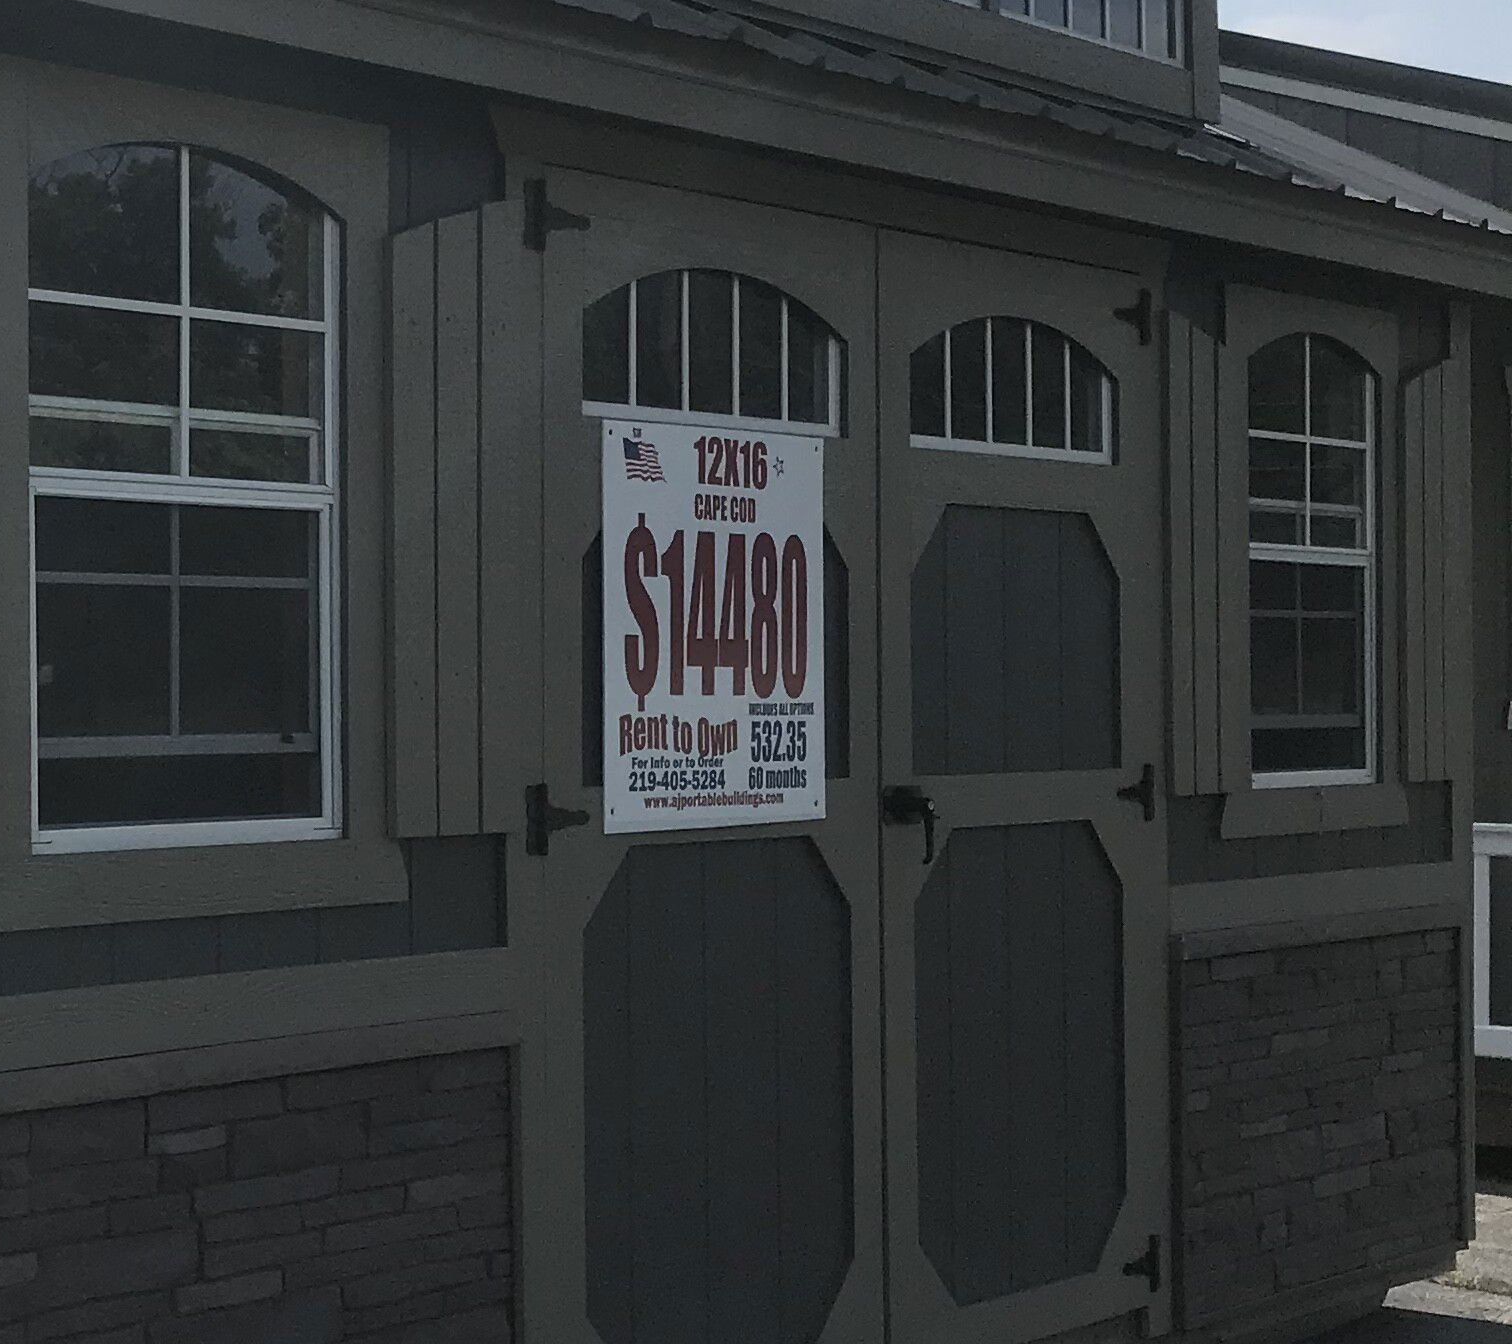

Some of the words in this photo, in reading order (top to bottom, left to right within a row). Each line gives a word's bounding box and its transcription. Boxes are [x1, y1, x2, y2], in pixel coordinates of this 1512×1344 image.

[694, 436, 768, 490] 12X16
[694, 493, 728, 522] CAPE
[730, 496, 757, 524] COD
[624, 513, 808, 711] $14480
[619, 714, 668, 757] Rent
[672, 715, 693, 755] to
[697, 717, 738, 757] Own
[750, 719, 807, 763] 532.35
[631, 757, 648, 770] For
[650, 756, 671, 769] Info
[673, 758, 684, 769] or
[685, 757, 696, 769] to
[697, 756, 724, 768] Order
[748, 766, 764, 790] 60
[765, 765, 807, 790] months
[628, 769, 726, 792] 219-405-5284
[644, 790, 784, 811] www.ajportablebuildings.com
